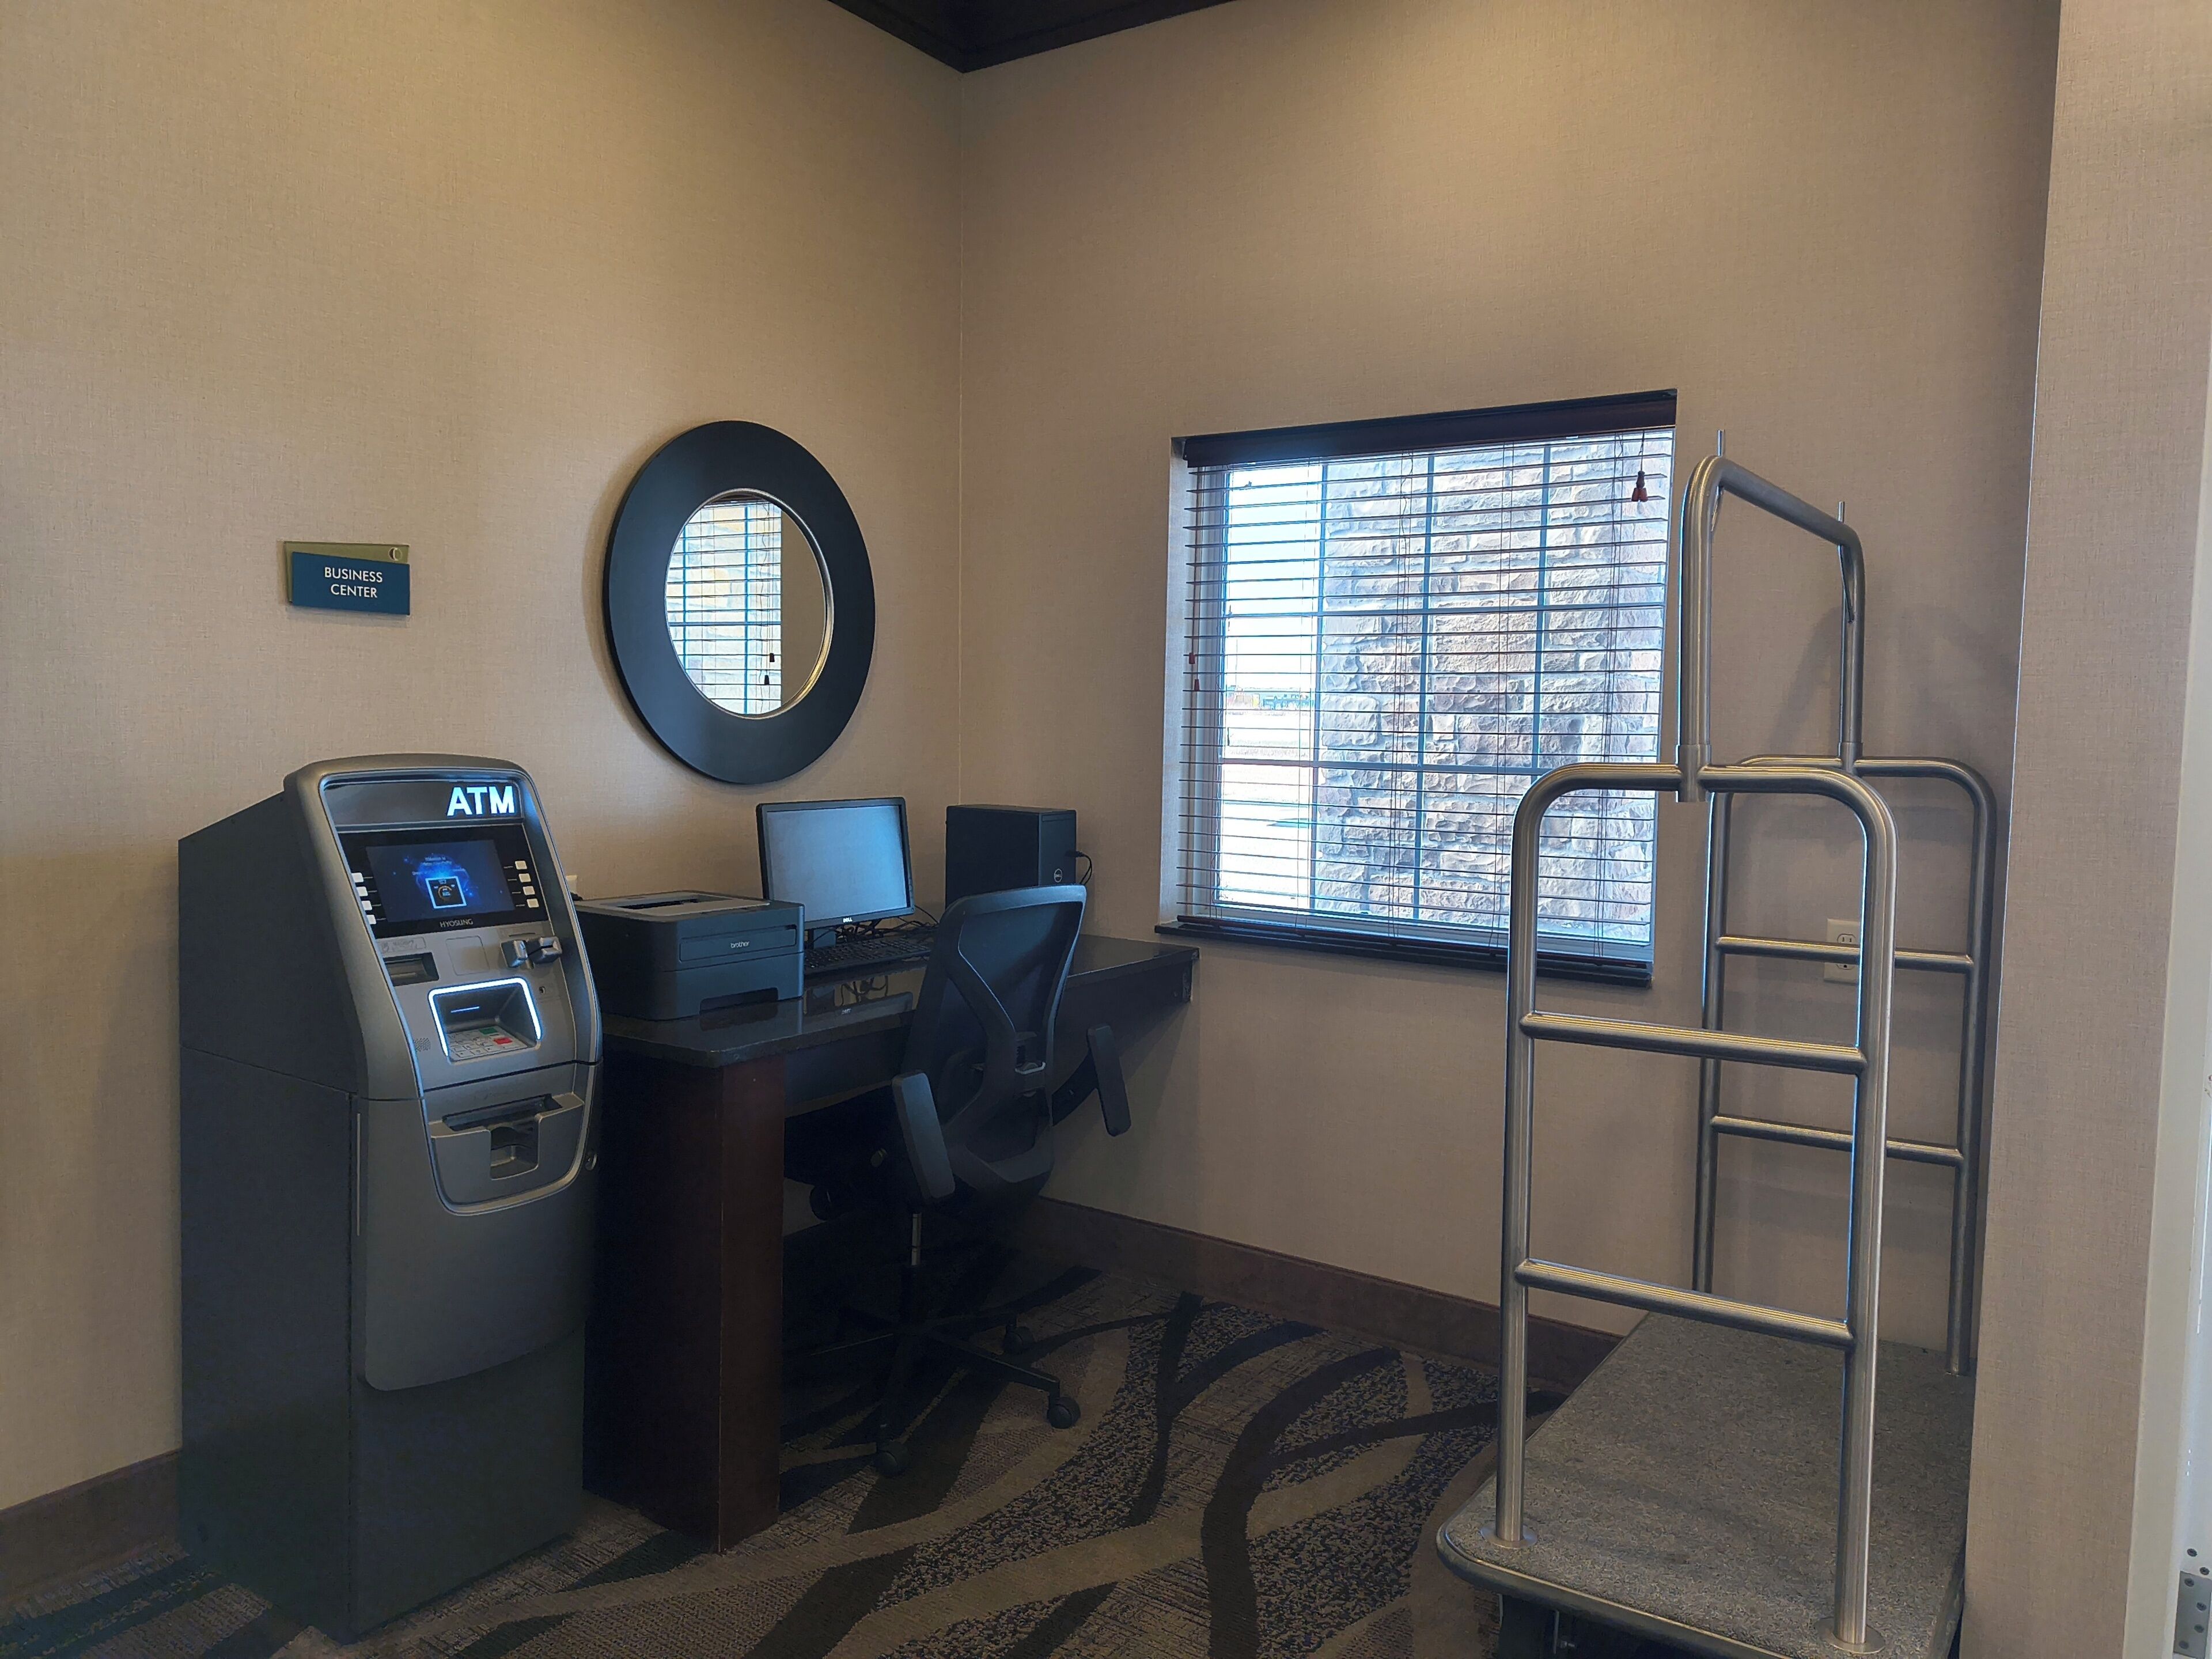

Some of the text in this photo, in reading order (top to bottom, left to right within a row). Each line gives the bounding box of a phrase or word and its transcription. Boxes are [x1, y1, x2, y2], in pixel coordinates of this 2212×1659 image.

[324, 566, 383, 583] BUSINESS
[331, 584, 378, 598] CENTER
[447, 786, 515, 816] ATM
[440, 918, 474, 928] HYOSUNG
[730, 941, 749, 949] brother
